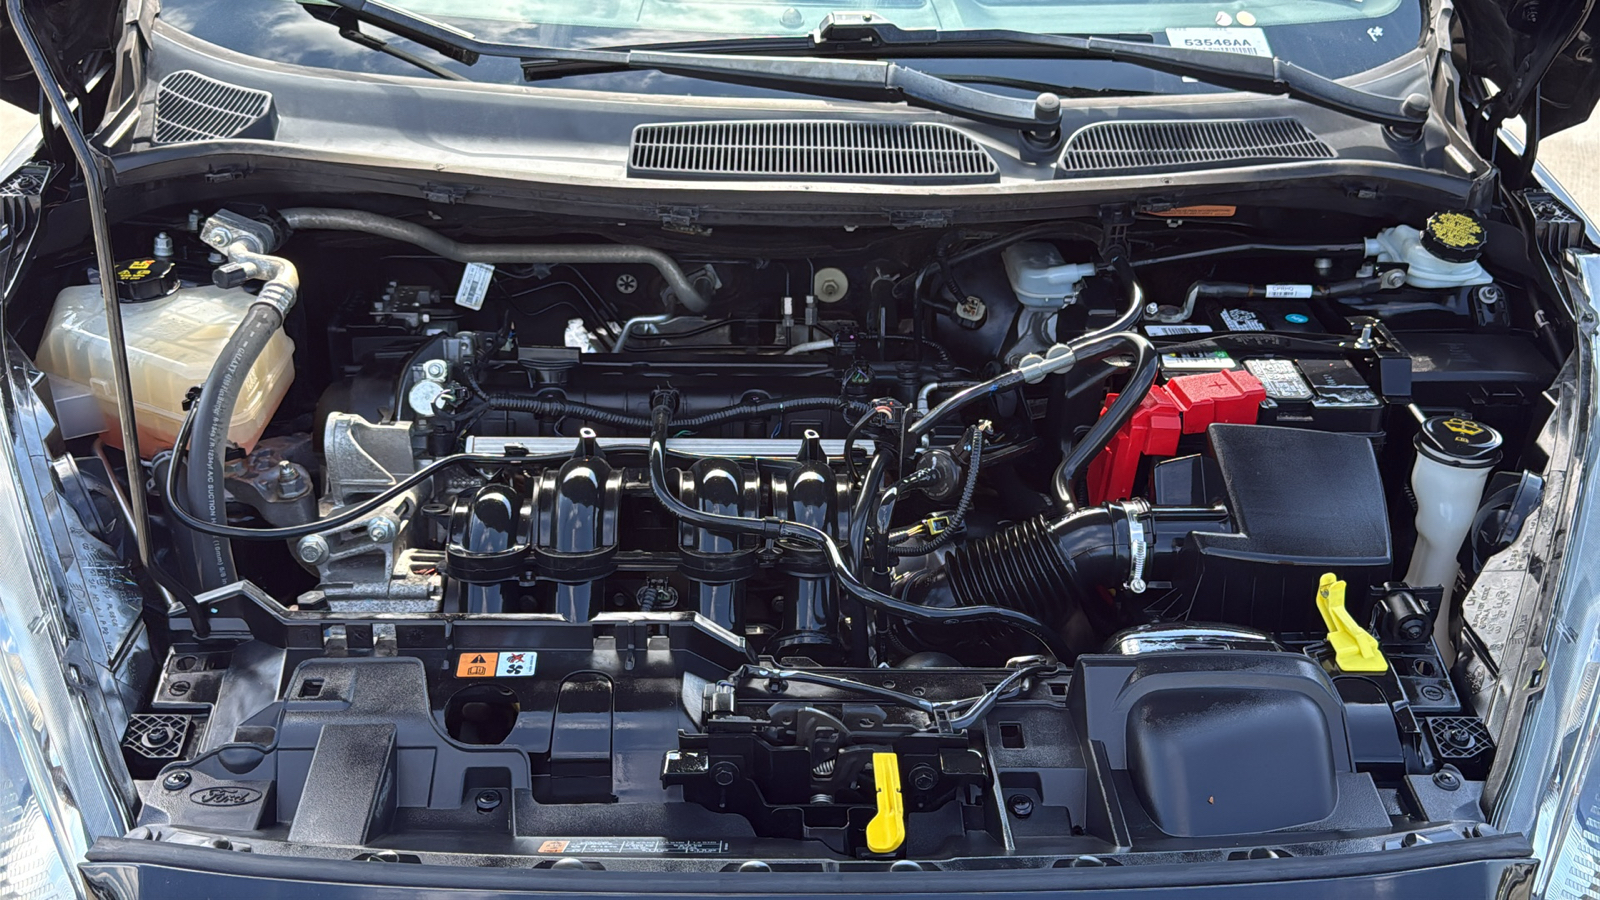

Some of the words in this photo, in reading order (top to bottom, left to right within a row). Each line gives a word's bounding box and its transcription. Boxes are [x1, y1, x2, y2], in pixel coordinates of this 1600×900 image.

[228, 348, 244, 374] GALAXY
[207, 484, 217, 516] SUCTION
[200, 787, 251, 804] Ford
